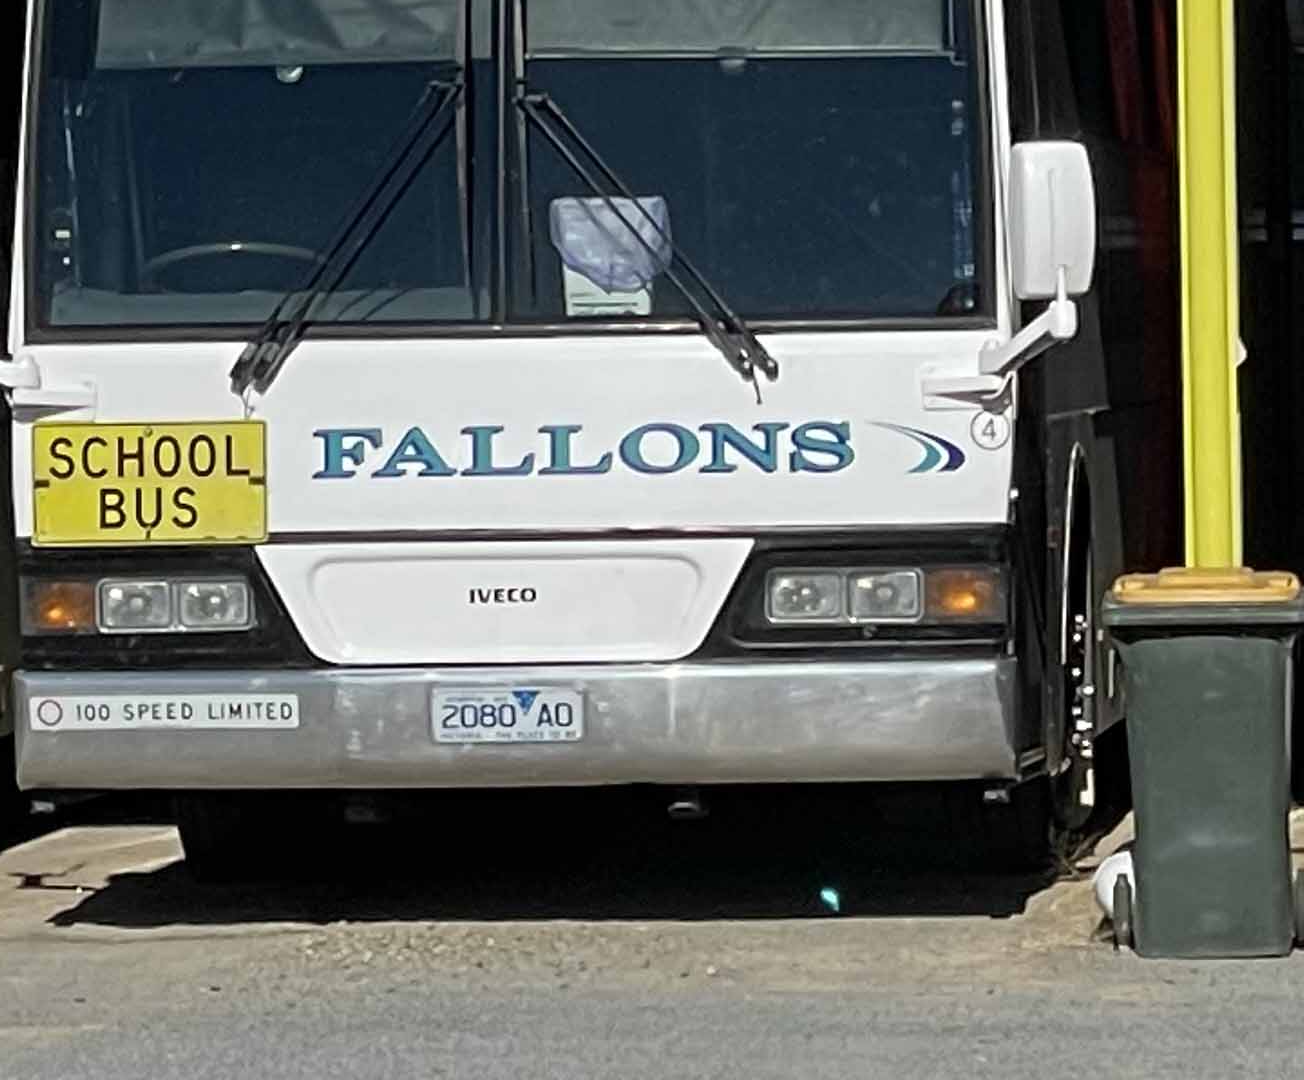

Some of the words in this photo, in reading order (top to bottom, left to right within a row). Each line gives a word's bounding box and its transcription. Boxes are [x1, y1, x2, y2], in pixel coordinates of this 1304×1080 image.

[48, 434, 251, 479] SCHOOL
[311, 419, 856, 480] FALLONS
[99, 486, 198, 529] BUS
[468, 586, 537, 604] IVECO
[75, 703, 111, 721] 100
[123, 702, 193, 721] SPEED
[207, 702, 293, 721] LIMITED
[441, 704, 517, 728] 2080
